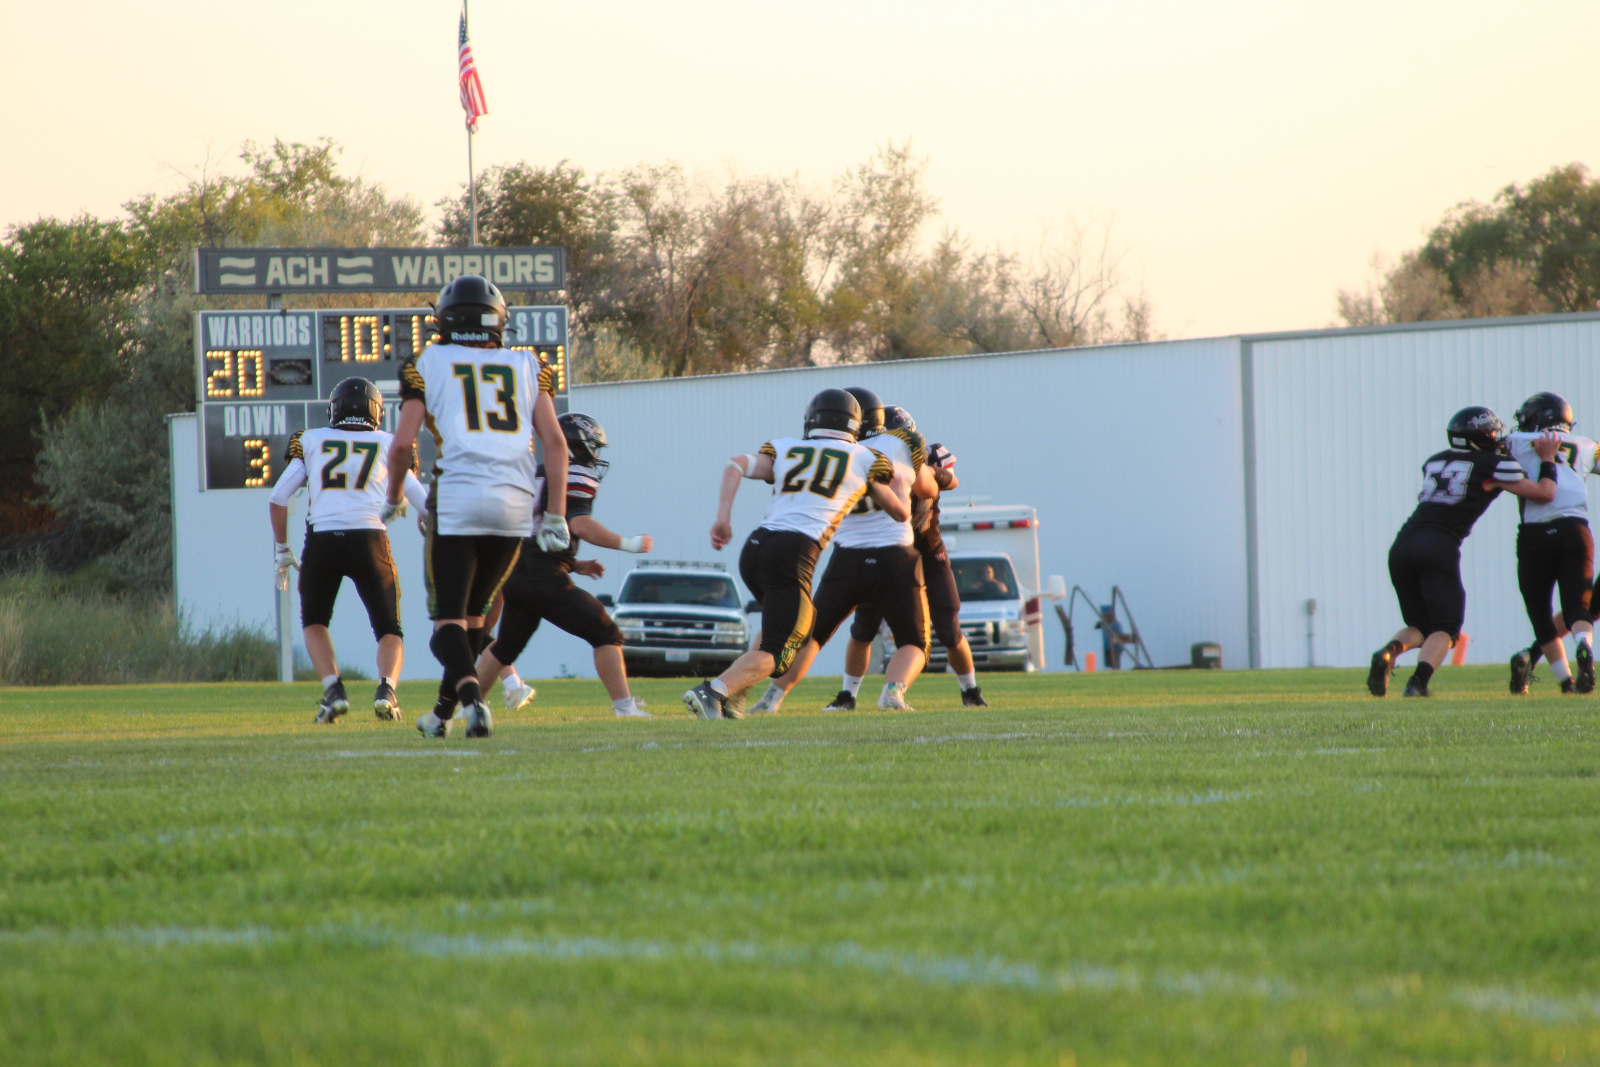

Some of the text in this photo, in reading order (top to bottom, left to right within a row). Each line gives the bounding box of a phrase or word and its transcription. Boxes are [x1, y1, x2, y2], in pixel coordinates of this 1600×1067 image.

[265, 254, 554, 286] ACH WARRIORS
[207, 315, 311, 347] WARRIORS
[451, 331, 489, 341] Riddell
[206, 350, 264, 397] 20
[223, 405, 287, 437] DOWN
[450, 362, 521, 434] 13
[244, 439, 271, 487] 3
[321, 439, 380, 491] 27
[781, 446, 850, 500] 20
[1418, 460, 1474, 505] 53
